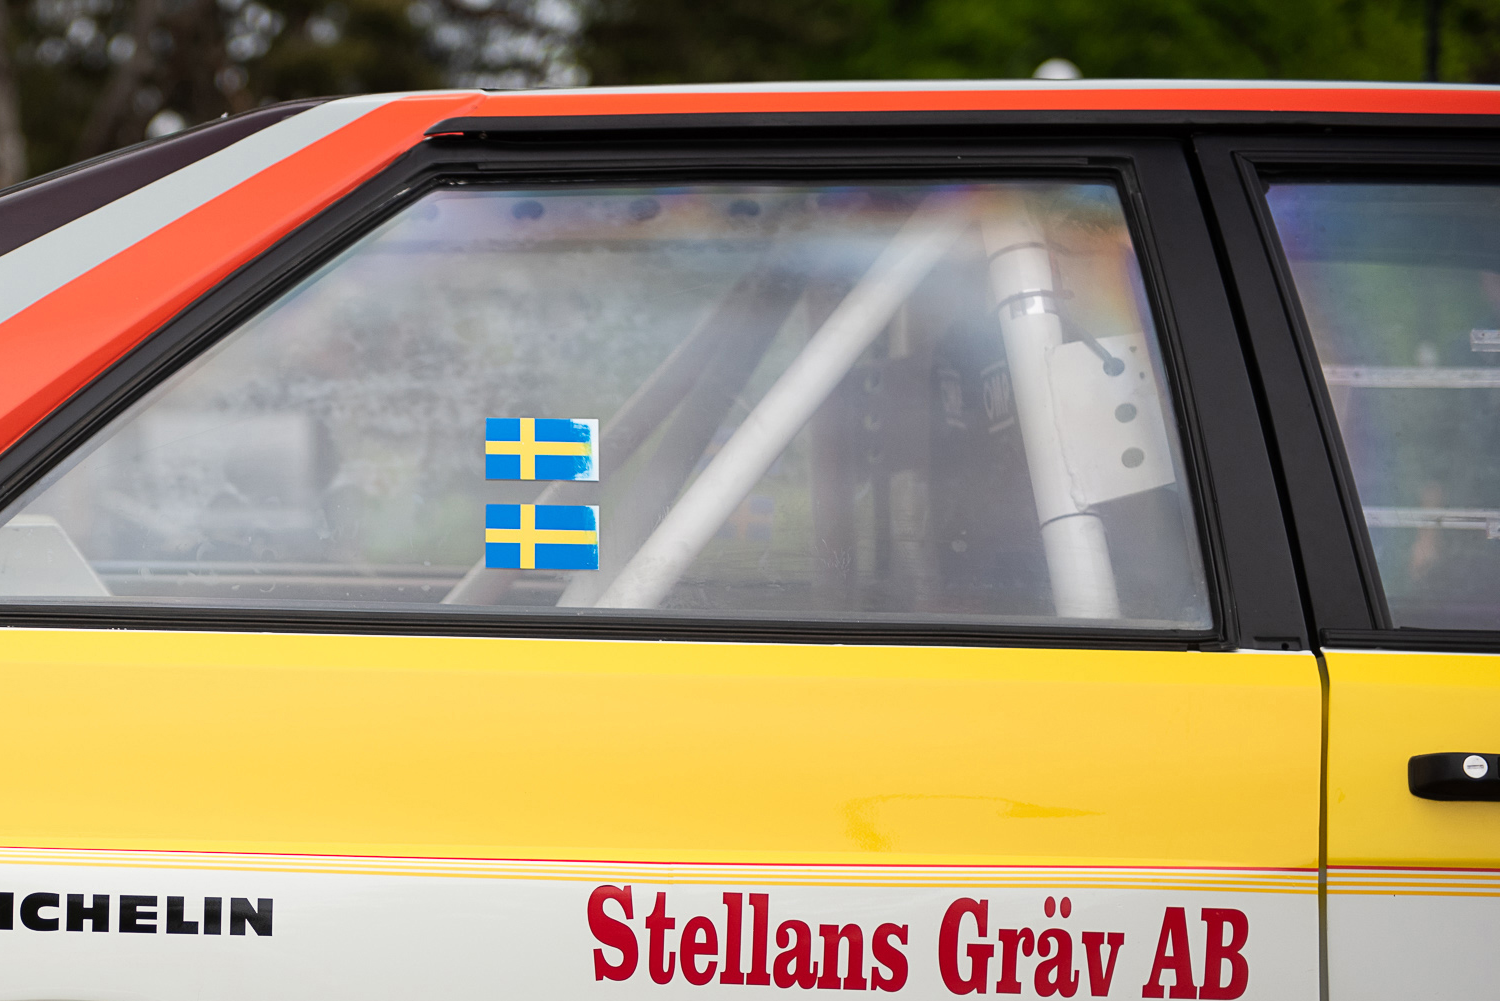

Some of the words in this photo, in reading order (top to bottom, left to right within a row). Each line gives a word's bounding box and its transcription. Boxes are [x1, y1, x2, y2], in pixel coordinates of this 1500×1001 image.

[587, 884, 909, 993] Stellans
[938, 896, 1125, 998] Gräv
[1142, 906, 1250, 1001] AB
